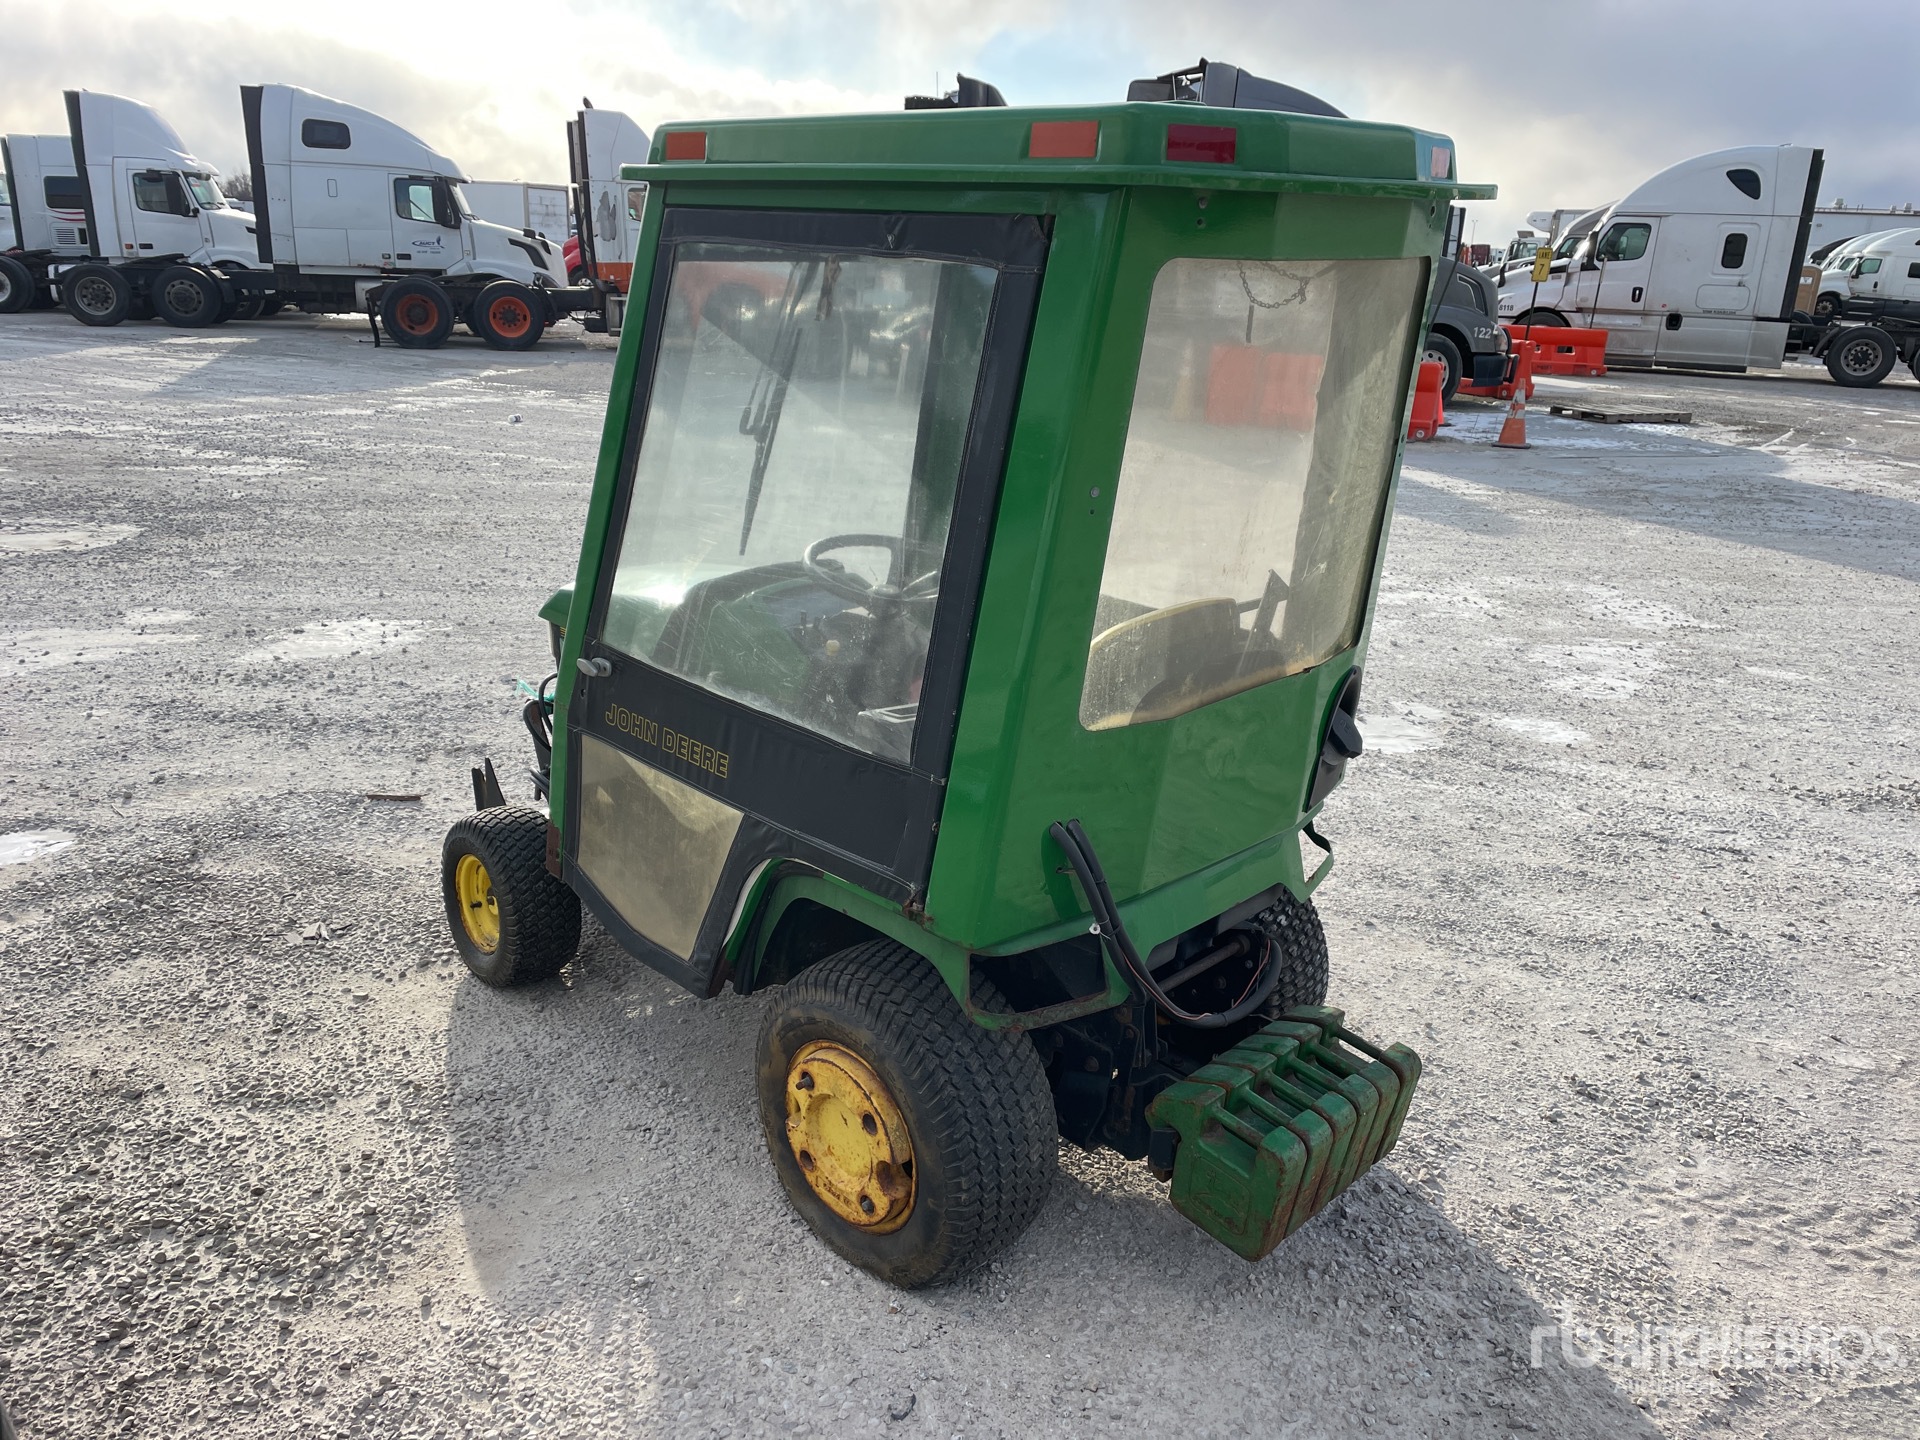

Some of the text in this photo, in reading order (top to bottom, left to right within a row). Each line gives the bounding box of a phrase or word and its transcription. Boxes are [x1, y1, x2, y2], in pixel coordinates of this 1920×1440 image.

[1538, 263, 1545, 276] 7
[1473, 326, 1492, 339] 122
[605, 703, 730, 779] JOHN DEERE
